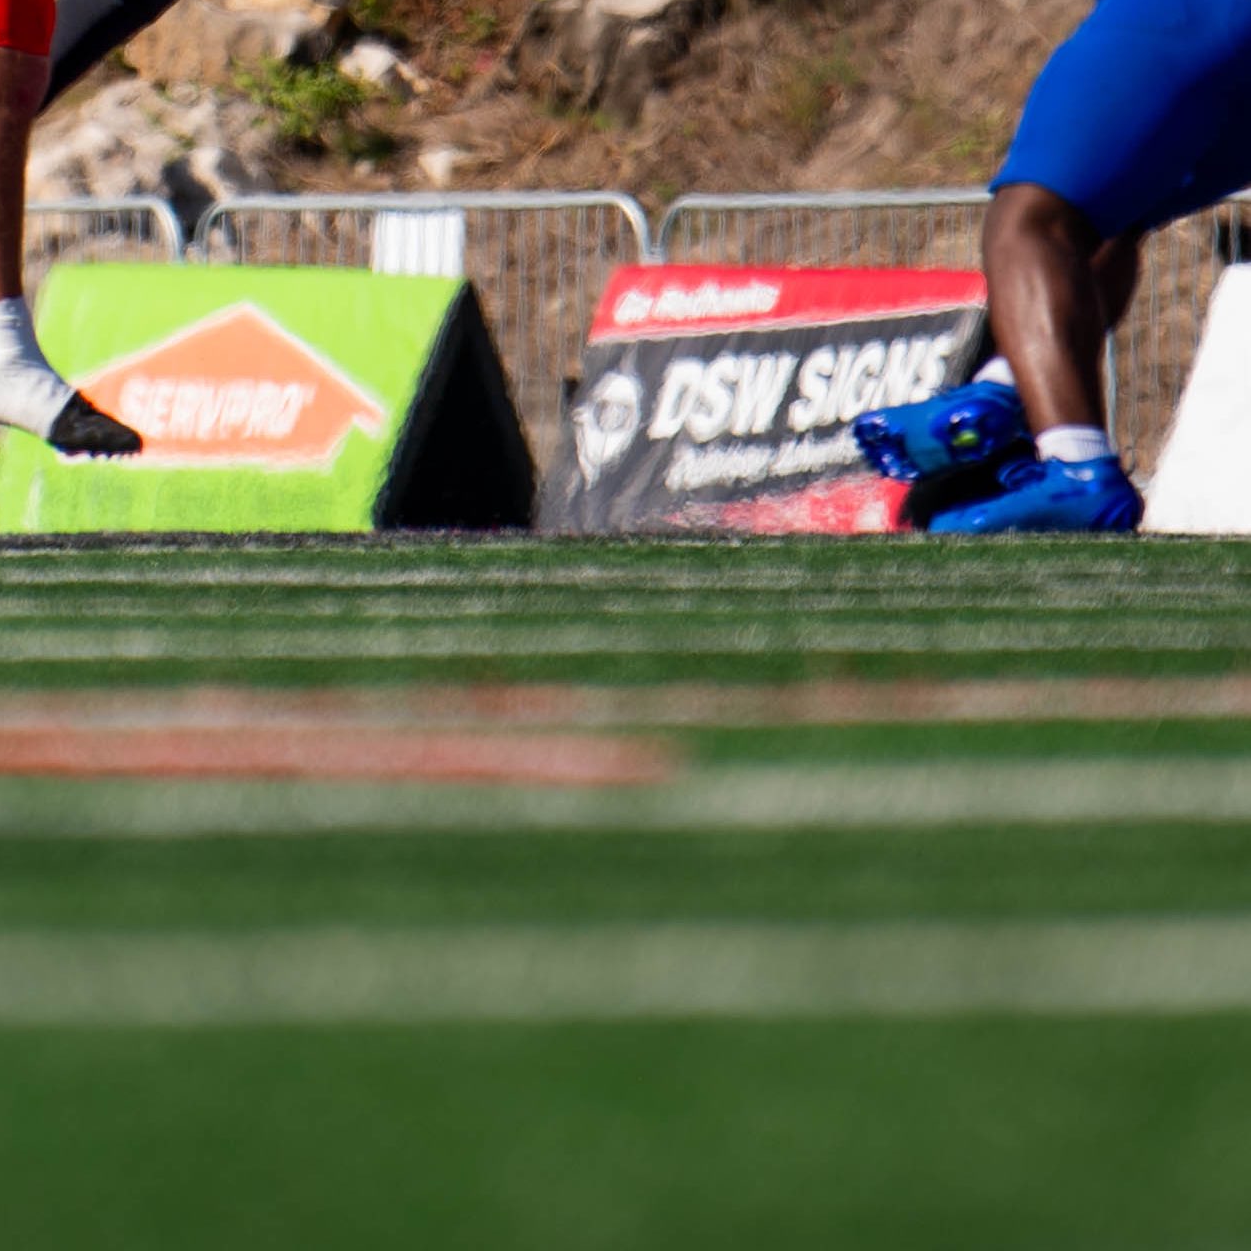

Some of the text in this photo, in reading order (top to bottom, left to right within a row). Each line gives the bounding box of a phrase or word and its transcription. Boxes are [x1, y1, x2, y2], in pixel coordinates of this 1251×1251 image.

[119, 377, 305, 440] SERVPRO
[648, 331, 956, 443] DSW SIGNS
